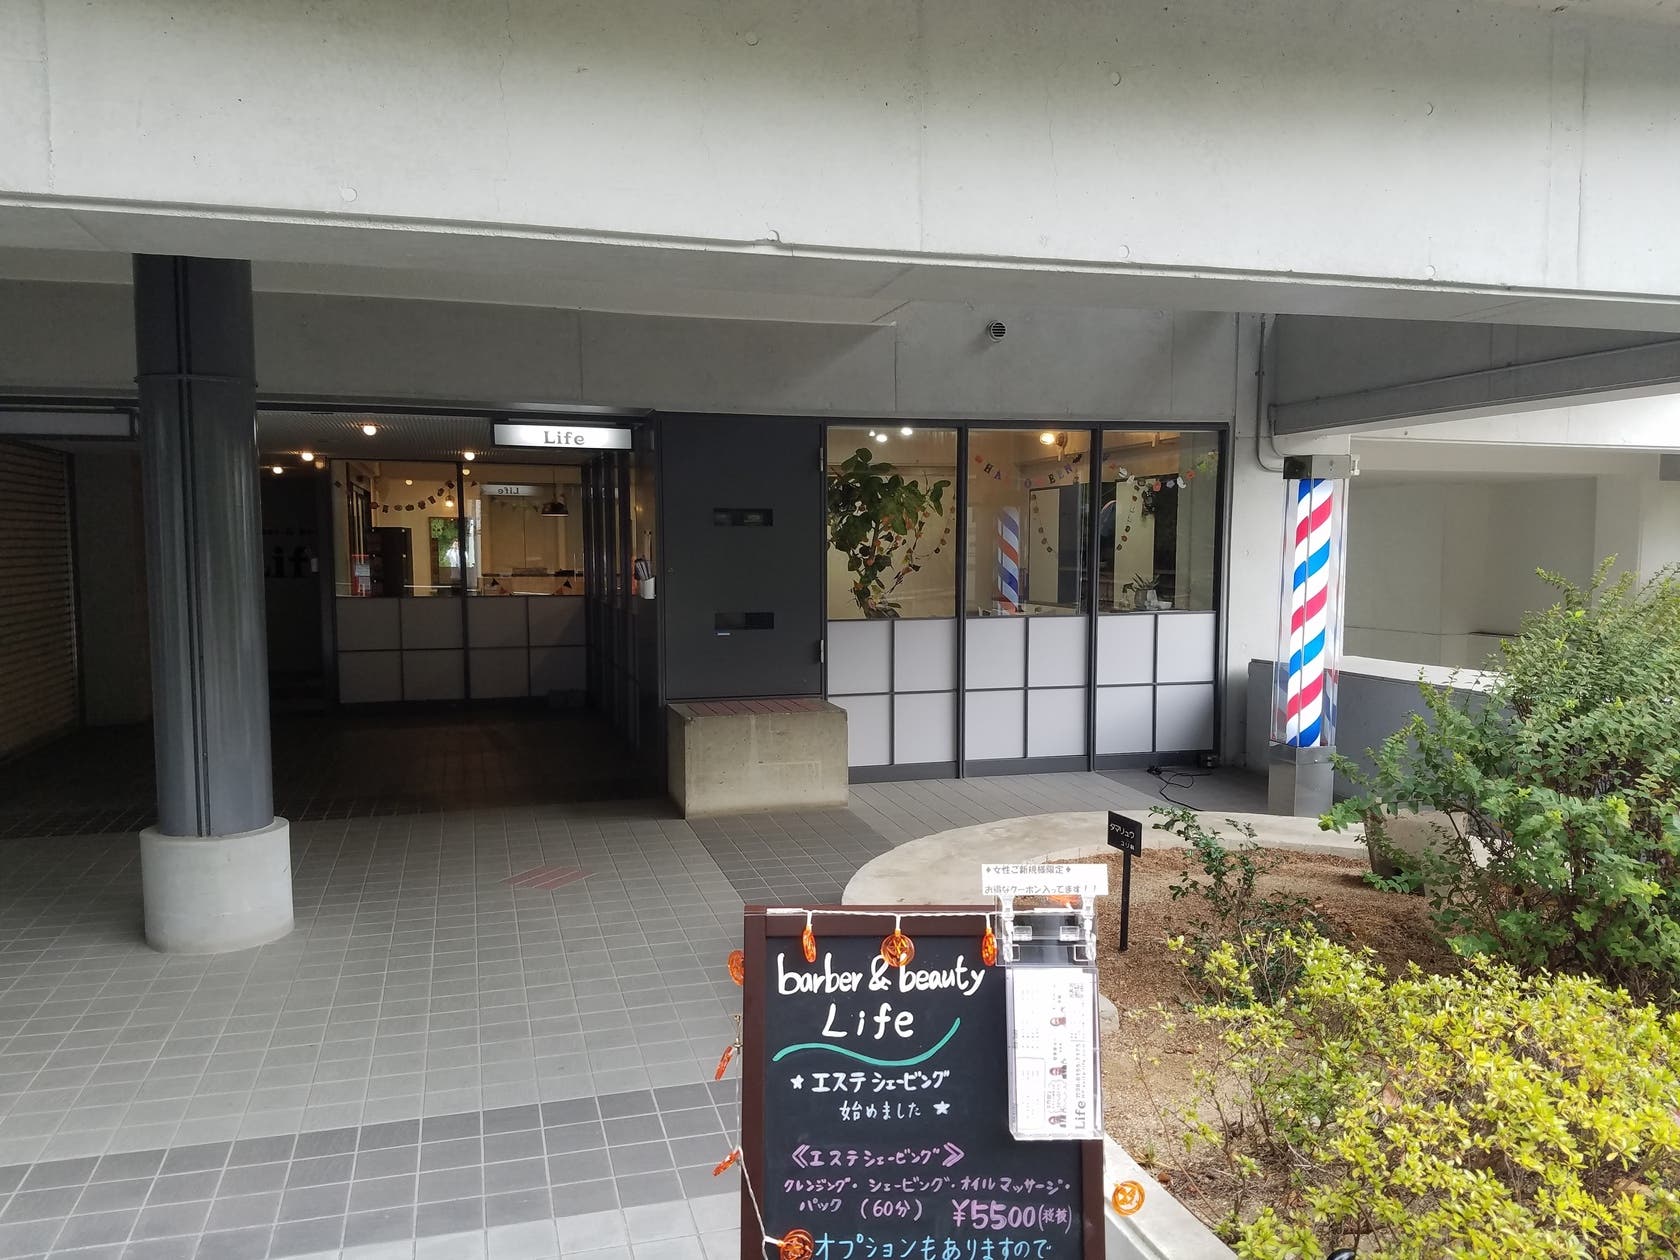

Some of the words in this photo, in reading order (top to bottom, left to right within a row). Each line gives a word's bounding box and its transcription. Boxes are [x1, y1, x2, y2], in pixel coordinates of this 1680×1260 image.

[543, 430, 585, 446] Life
[777, 952, 862, 996] barber
[868, 955, 892, 992] &
[899, 953, 985, 997] beauty
[821, 1002, 914, 1040] Life
[839, 1100, 921, 1121] 始めました
[1074, 1100, 1087, 1130] Life
[799, 1197, 843, 1213] パック
[815, 1232, 1052, 1260] オプションもありますので
